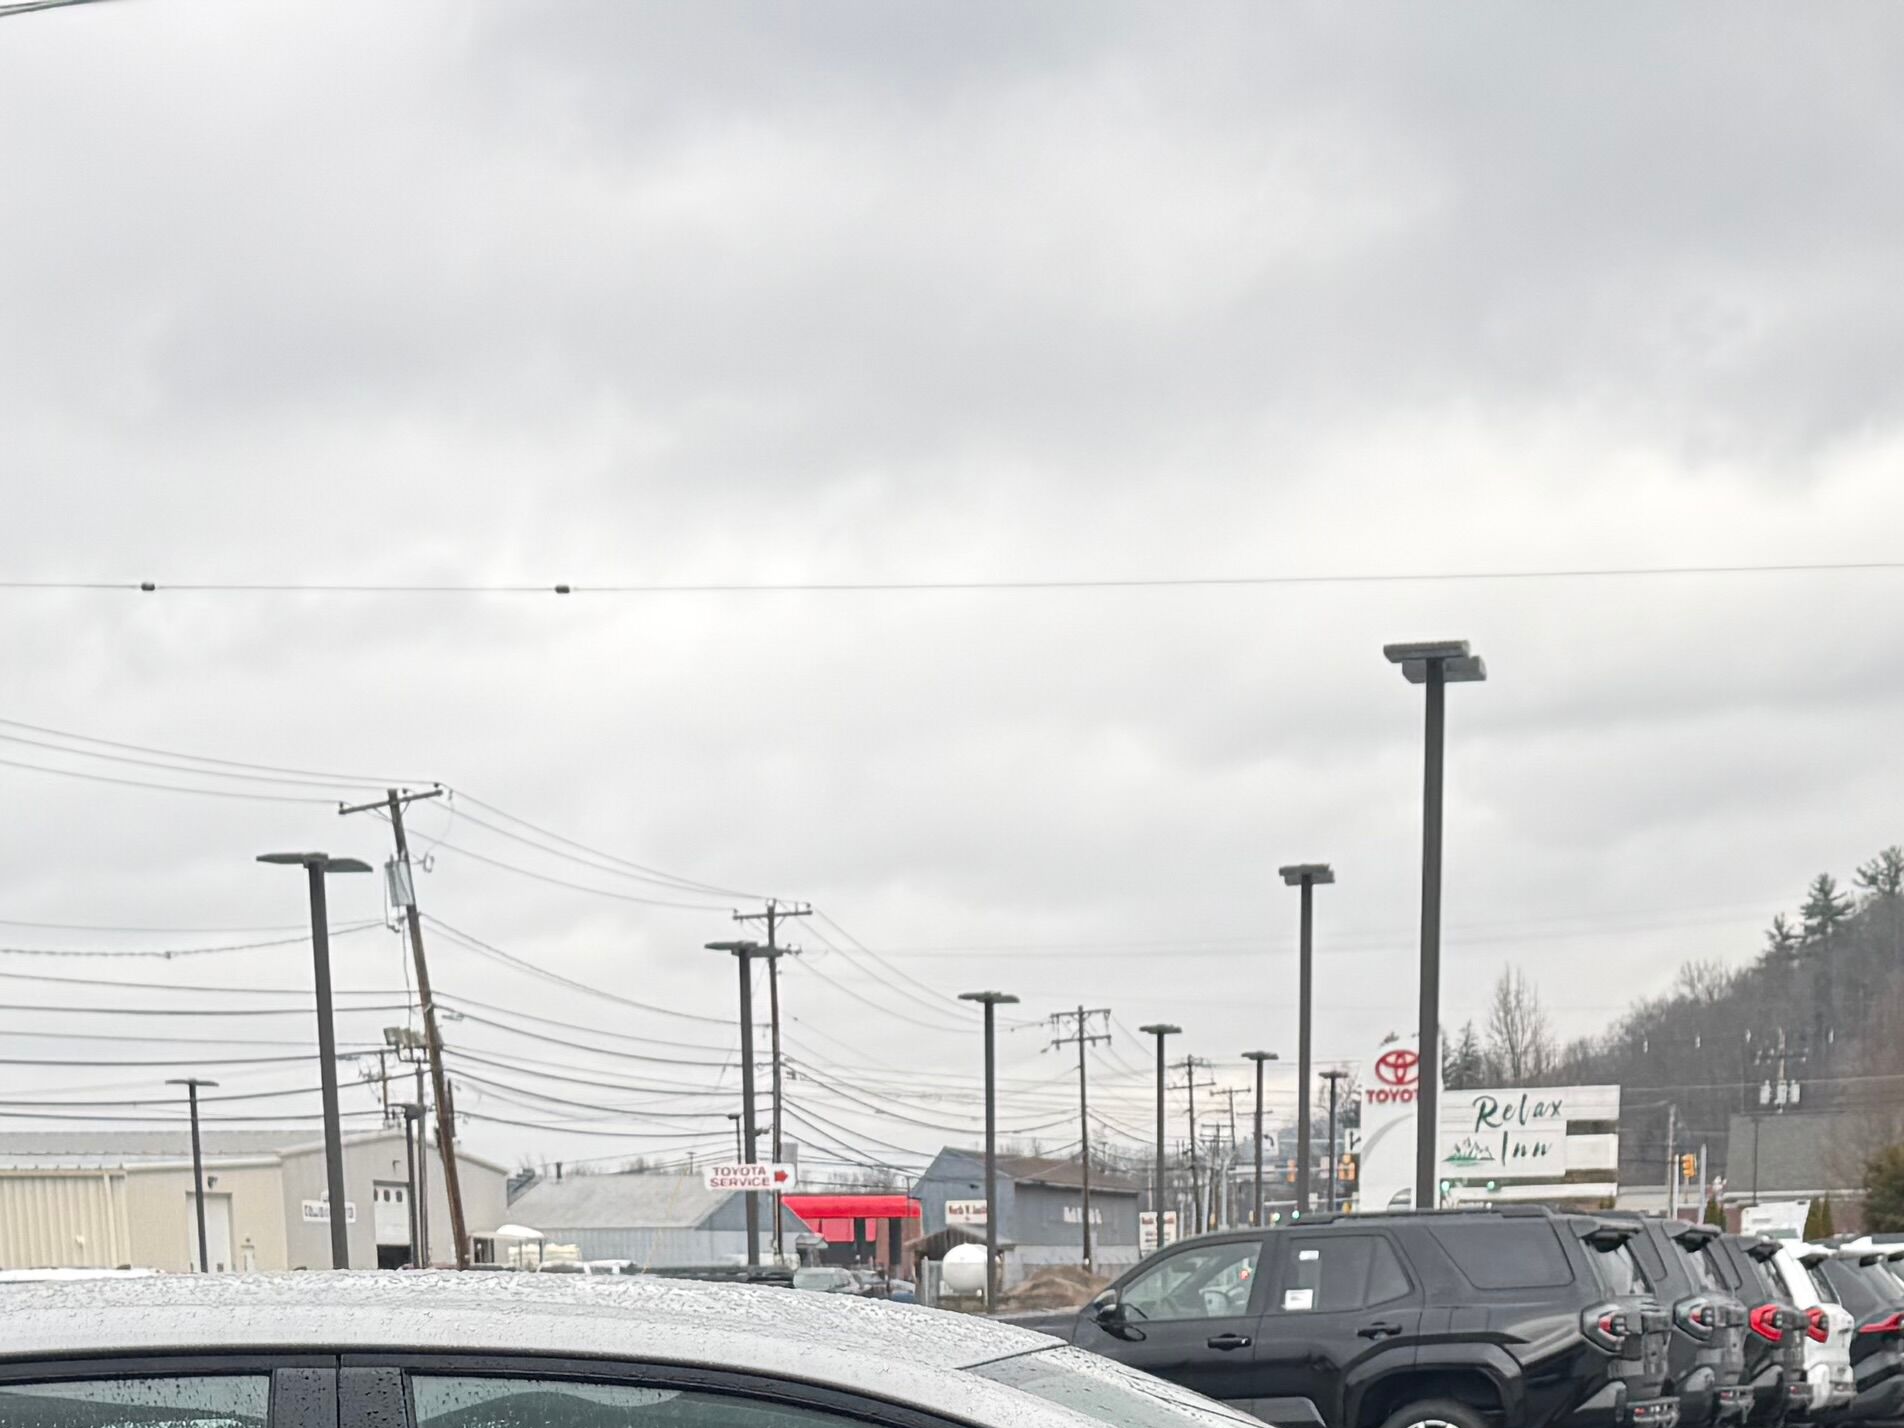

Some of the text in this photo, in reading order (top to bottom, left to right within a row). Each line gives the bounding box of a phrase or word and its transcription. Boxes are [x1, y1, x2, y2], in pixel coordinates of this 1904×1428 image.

[1366, 1088, 1419, 1104] TOYO
[1472, 1093, 1564, 1133] Relax
[1501, 1131, 1553, 1166] Inn
[712, 1166, 767, 1177] TOYOTA
[710, 1177, 771, 1188] SERVICE
